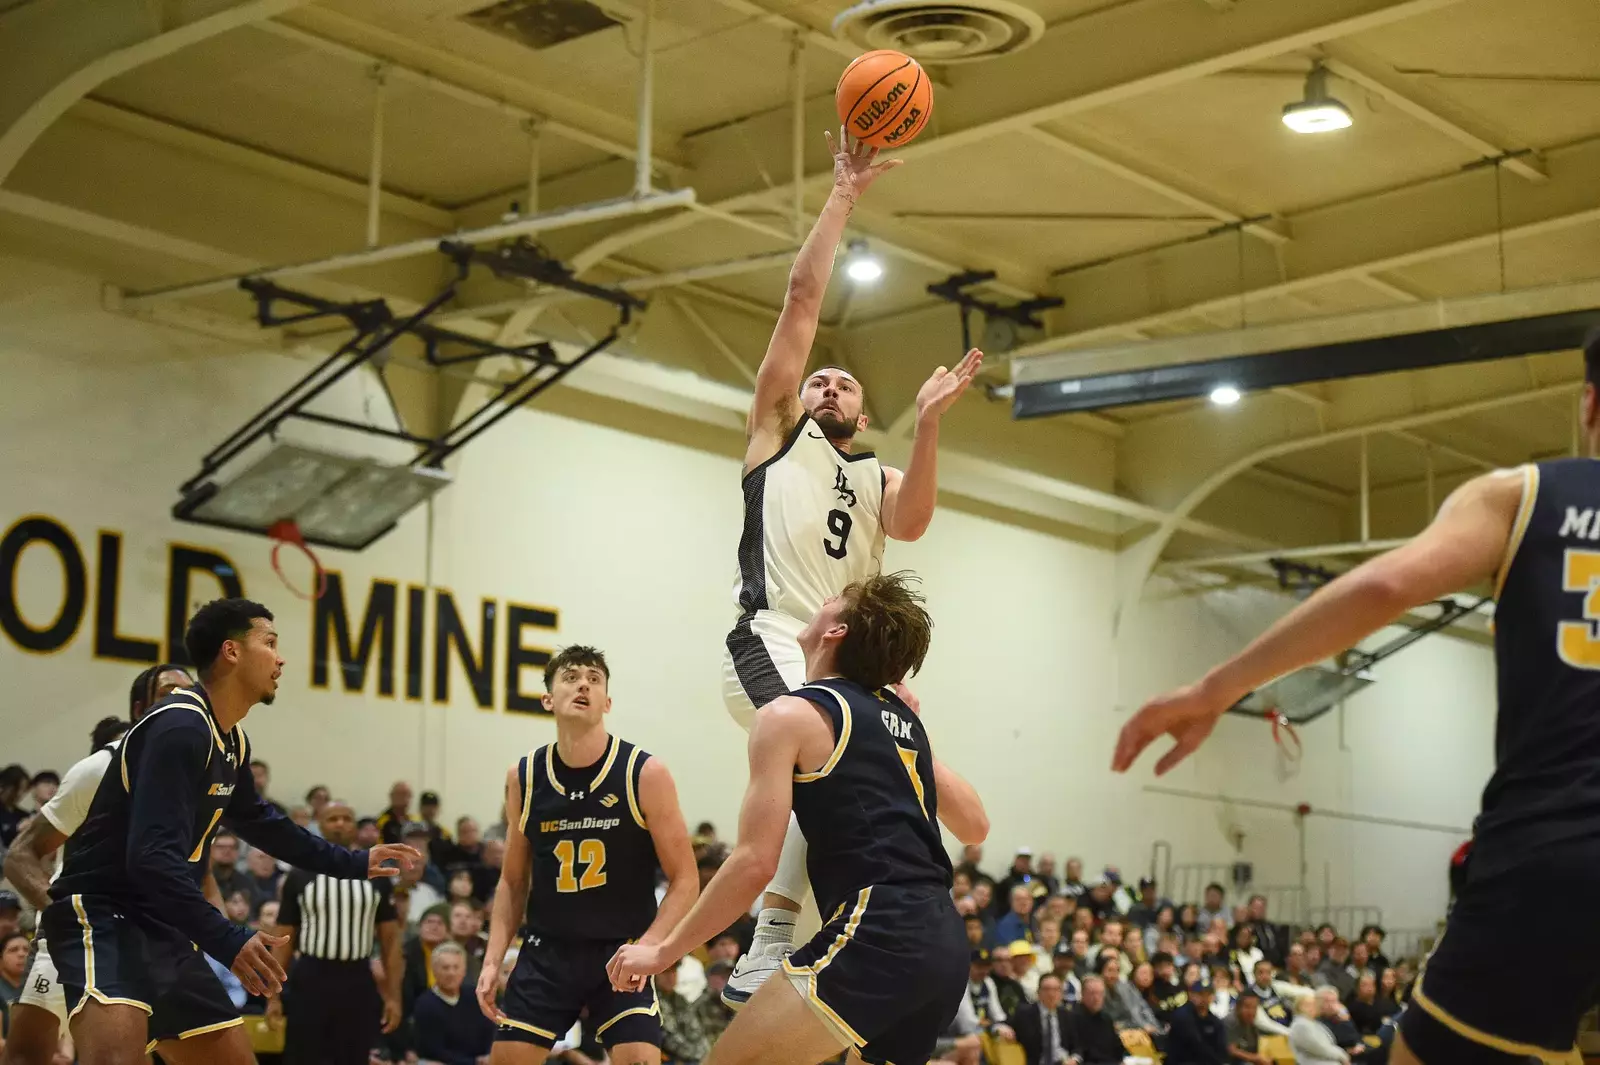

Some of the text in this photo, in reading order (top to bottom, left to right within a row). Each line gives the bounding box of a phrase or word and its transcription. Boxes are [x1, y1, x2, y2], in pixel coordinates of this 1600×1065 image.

[854, 82, 908, 131] Wilson
[883, 107, 921, 143] NCAA
[823, 508, 853, 560] 9
[311, 569, 560, 717] MINE
[553, 838, 607, 893] 12
